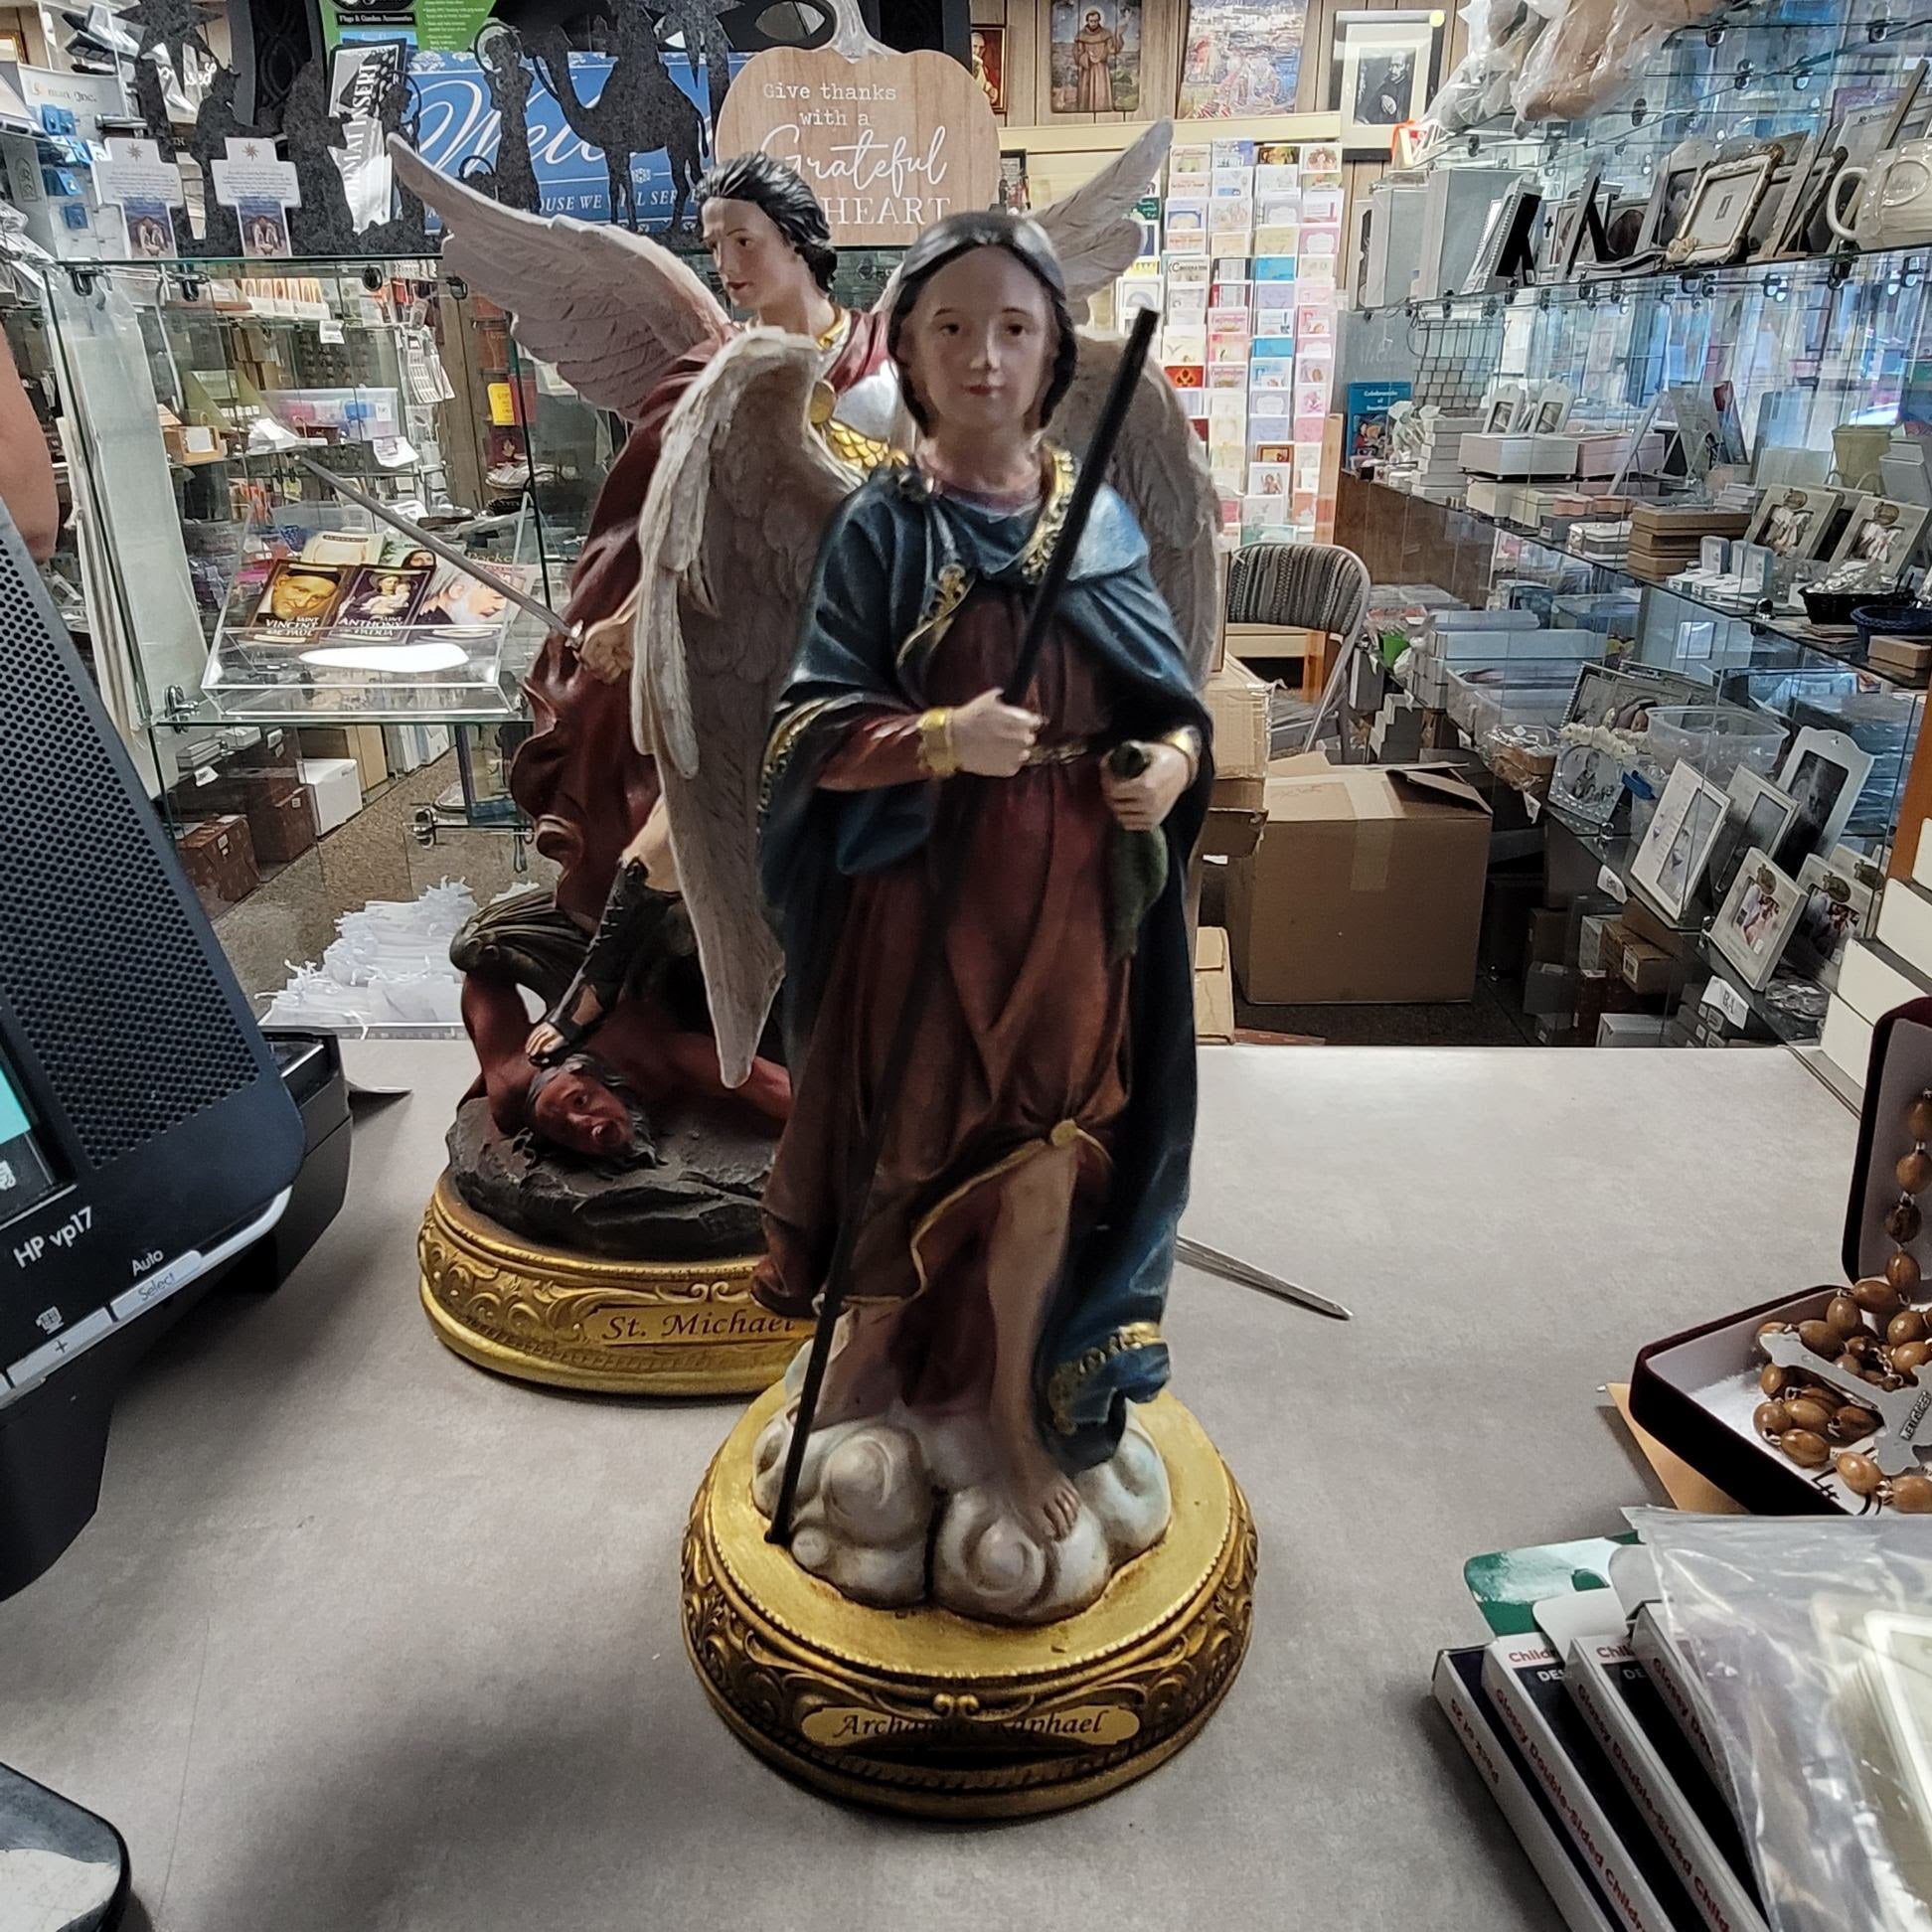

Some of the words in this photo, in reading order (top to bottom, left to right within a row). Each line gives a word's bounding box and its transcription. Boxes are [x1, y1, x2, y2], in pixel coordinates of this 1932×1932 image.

[347, 63, 384, 127] INSERT
[763, 82, 810, 99] Give
[820, 82, 896, 100] thanks
[799, 110, 848, 126] with
[858, 114, 871, 126] a
[760, 123, 947, 199] Grateful
[540, 195, 574, 213] USE
[580, 194, 602, 210] WE
[823, 197, 951, 225] HEART
[265, 619, 319, 629] VINCENT
[339, 616, 403, 627] ANTHONY
[13, 1235, 46, 1269] HP
[50, 1206, 91, 1248] vp17
[131, 1250, 164, 1277] Auto
[138, 1273, 176, 1303] Select
[601, 1316, 646, 1341] St.
[1653, 1658, 1690, 1717] Glossy
[833, 1713, 975, 1737] Archan
[1495, 1689, 1530, 1743] Glossy
[1529, 1742, 1604, 1869] Double-Sided
[1577, 1684, 1612, 1743] Glossy
[1612, 1742, 1693, 1876] Double-Sided
